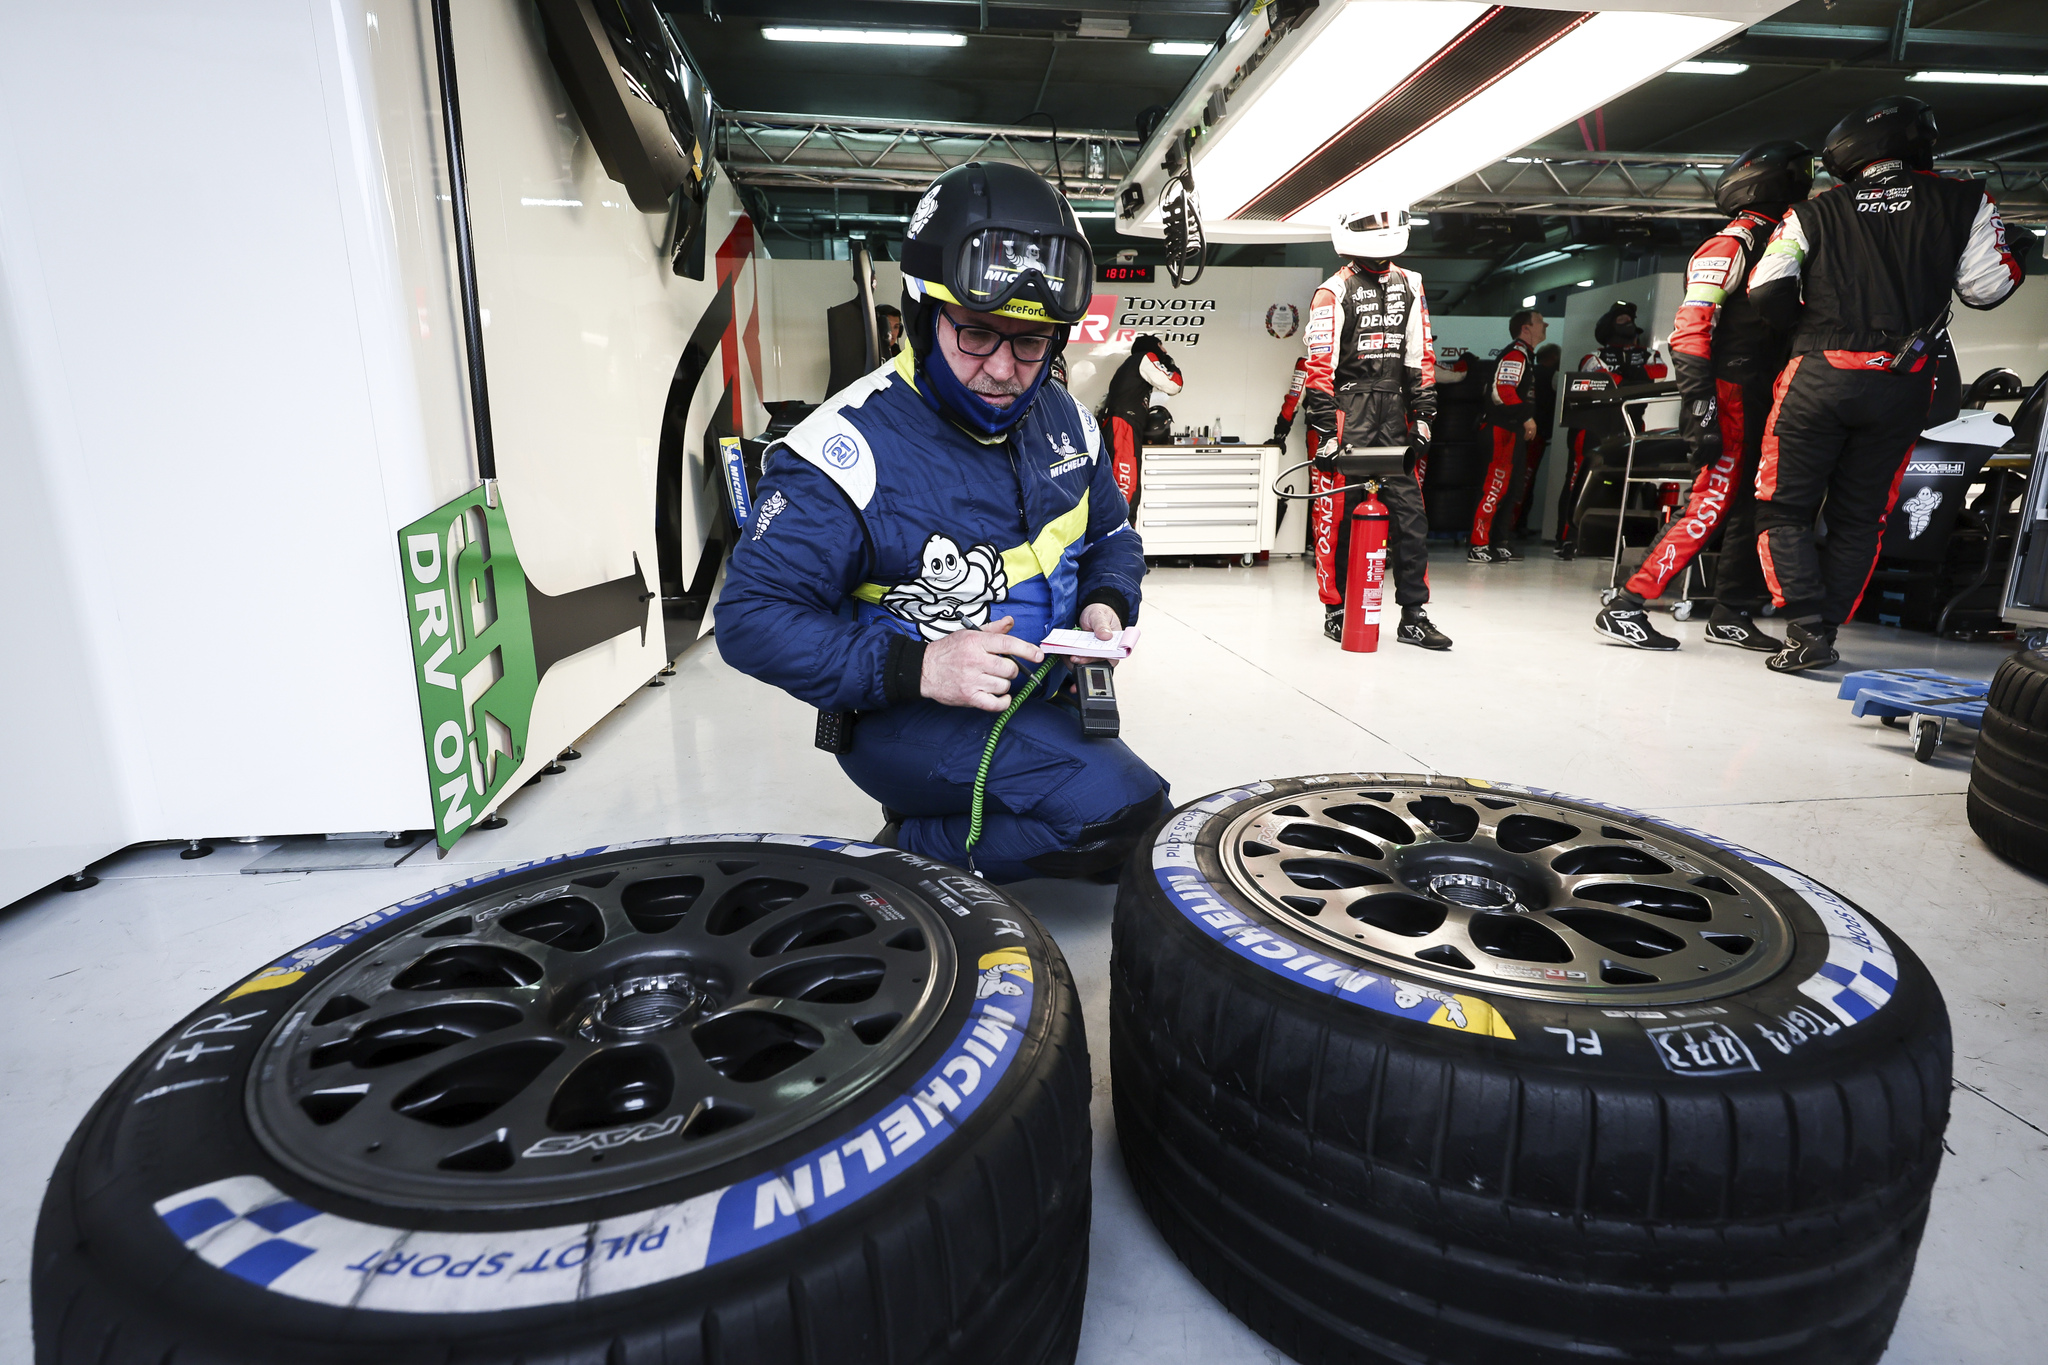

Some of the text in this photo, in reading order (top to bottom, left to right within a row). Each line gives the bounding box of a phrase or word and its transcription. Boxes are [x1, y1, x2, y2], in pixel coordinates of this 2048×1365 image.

[1857, 200, 1912, 213] DENSO
[984, 270, 1064, 292] MICIN
[1351, 286, 1377, 303] FUJITSU
[1119, 313, 1206, 327] GAZOO
[1123, 296, 1217, 312] TOYOTA
[1360, 313, 1404, 328] DENSO
[1441, 347, 1469, 357] ZENT
[730, 465, 748, 518] MICHELIN
[1119, 462, 1131, 498] DEN
[1482, 468, 1506, 513] DENSO
[1685, 455, 1736, 539] DENSO
[1318, 474, 1334, 555] DENSO
[407, 533, 472, 835] DRV ON
[1167, 807, 1200, 858] PILOT SPORT
[1167, 874, 1379, 994] MICHELIN
[1834, 909, 1874, 954] SPORT
[1543, 1026, 1602, 1056] FL
[753, 1003, 1017, 1231] MICHELIN
[346, 1224, 670, 1279] PILOT SPORT
